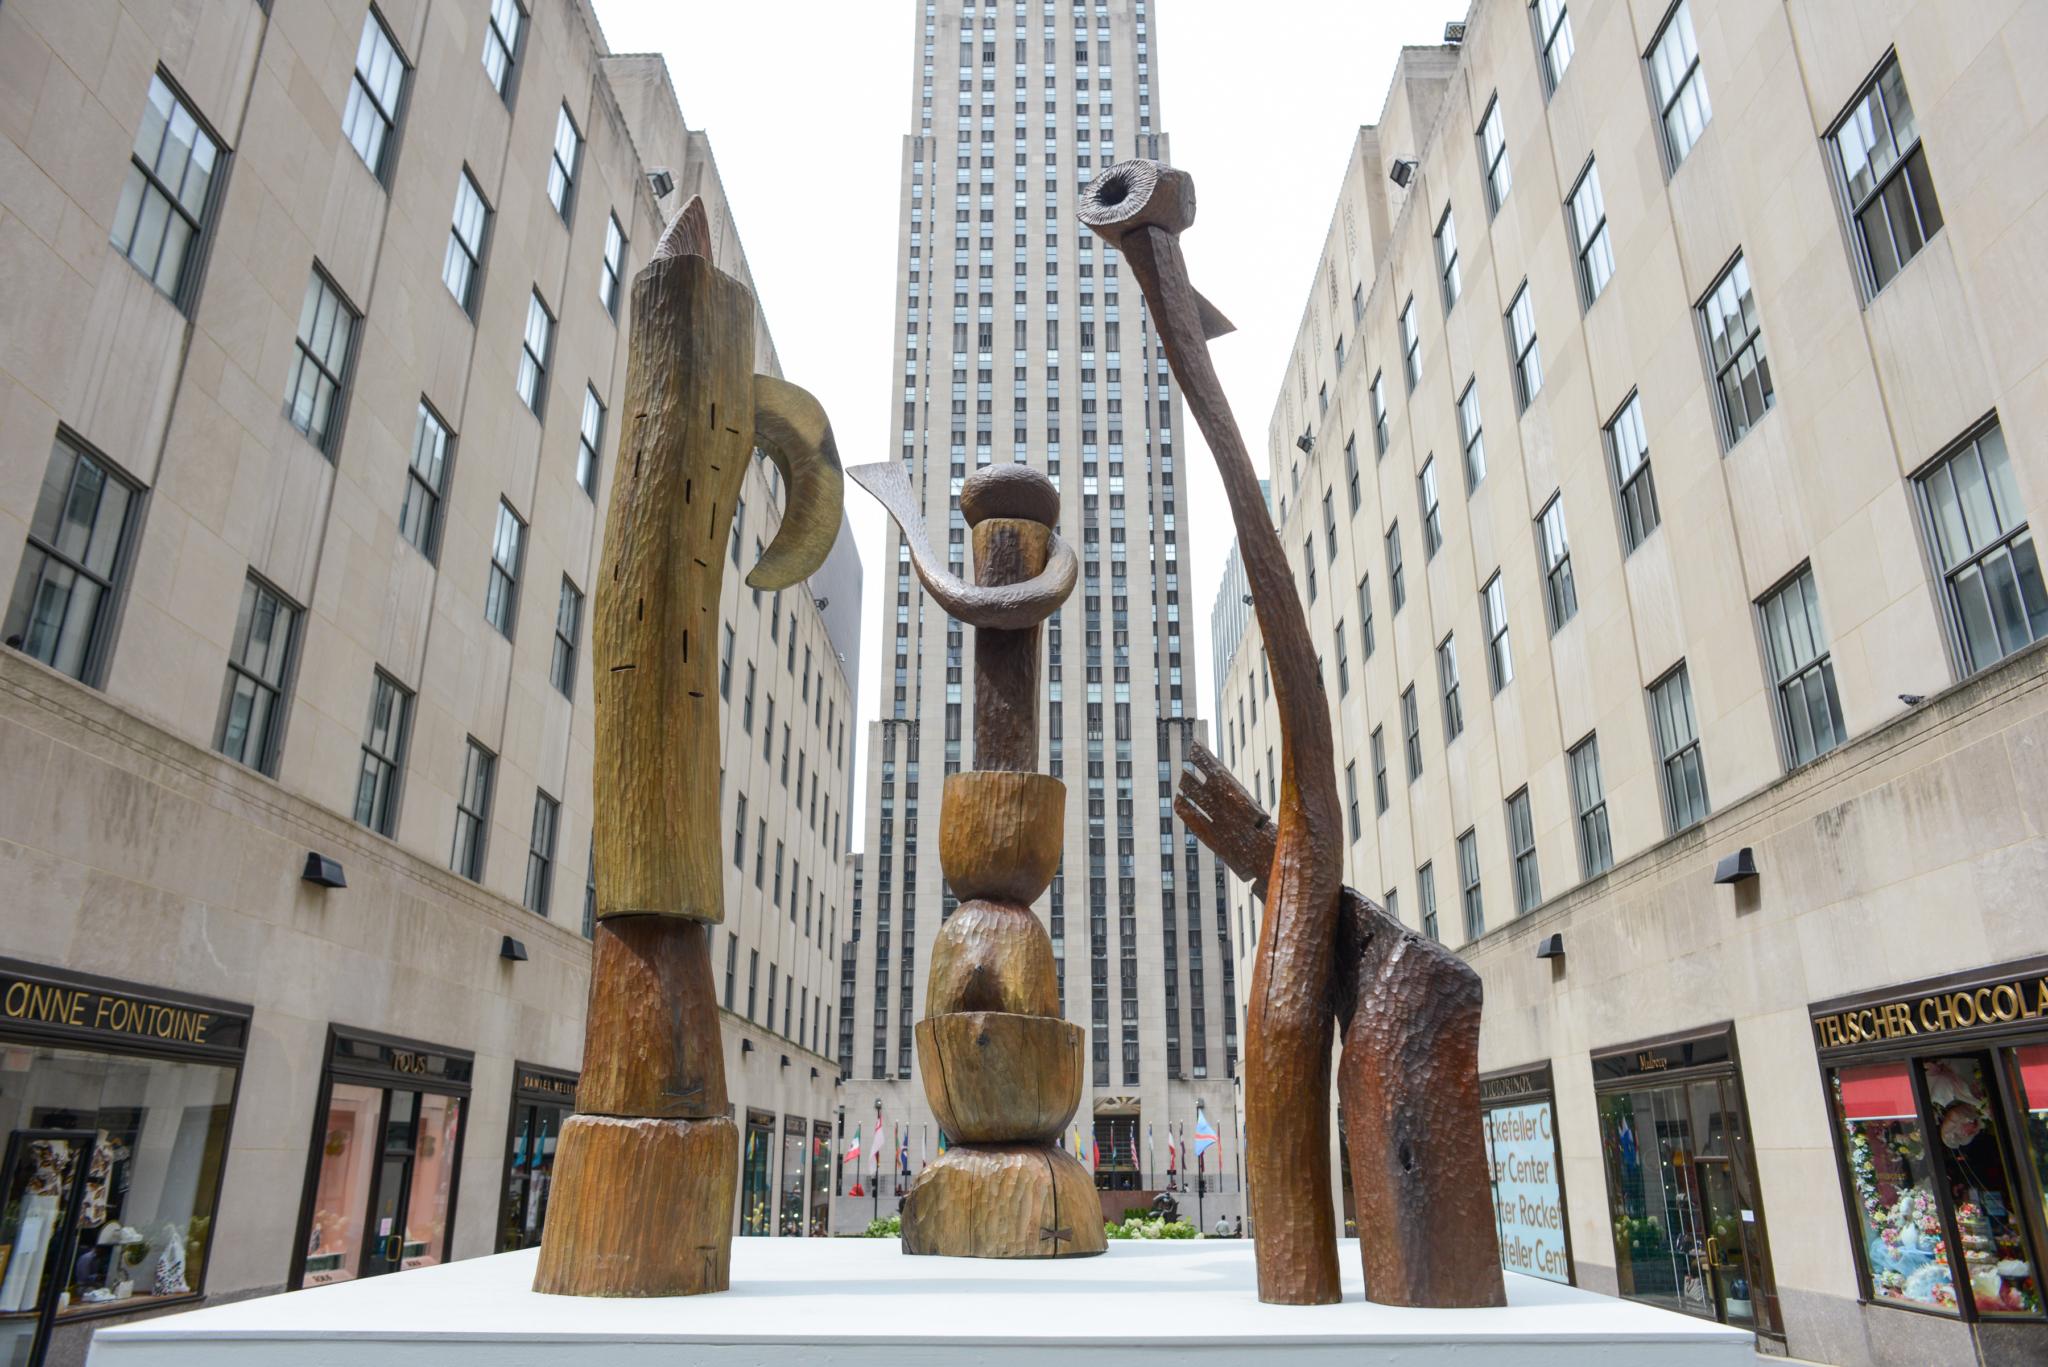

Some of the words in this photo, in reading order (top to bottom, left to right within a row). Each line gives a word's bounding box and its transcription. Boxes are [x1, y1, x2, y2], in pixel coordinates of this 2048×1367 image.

[1815, 1003, 1917, 1048] TEUSCHER
[1919, 976, 2048, 1031] CHOCOLA
[392, 1049, 426, 1073] TOUS
[1639, 1050, 1667, 1071] Mulberry
[1508, 1152, 1549, 1184] Center
